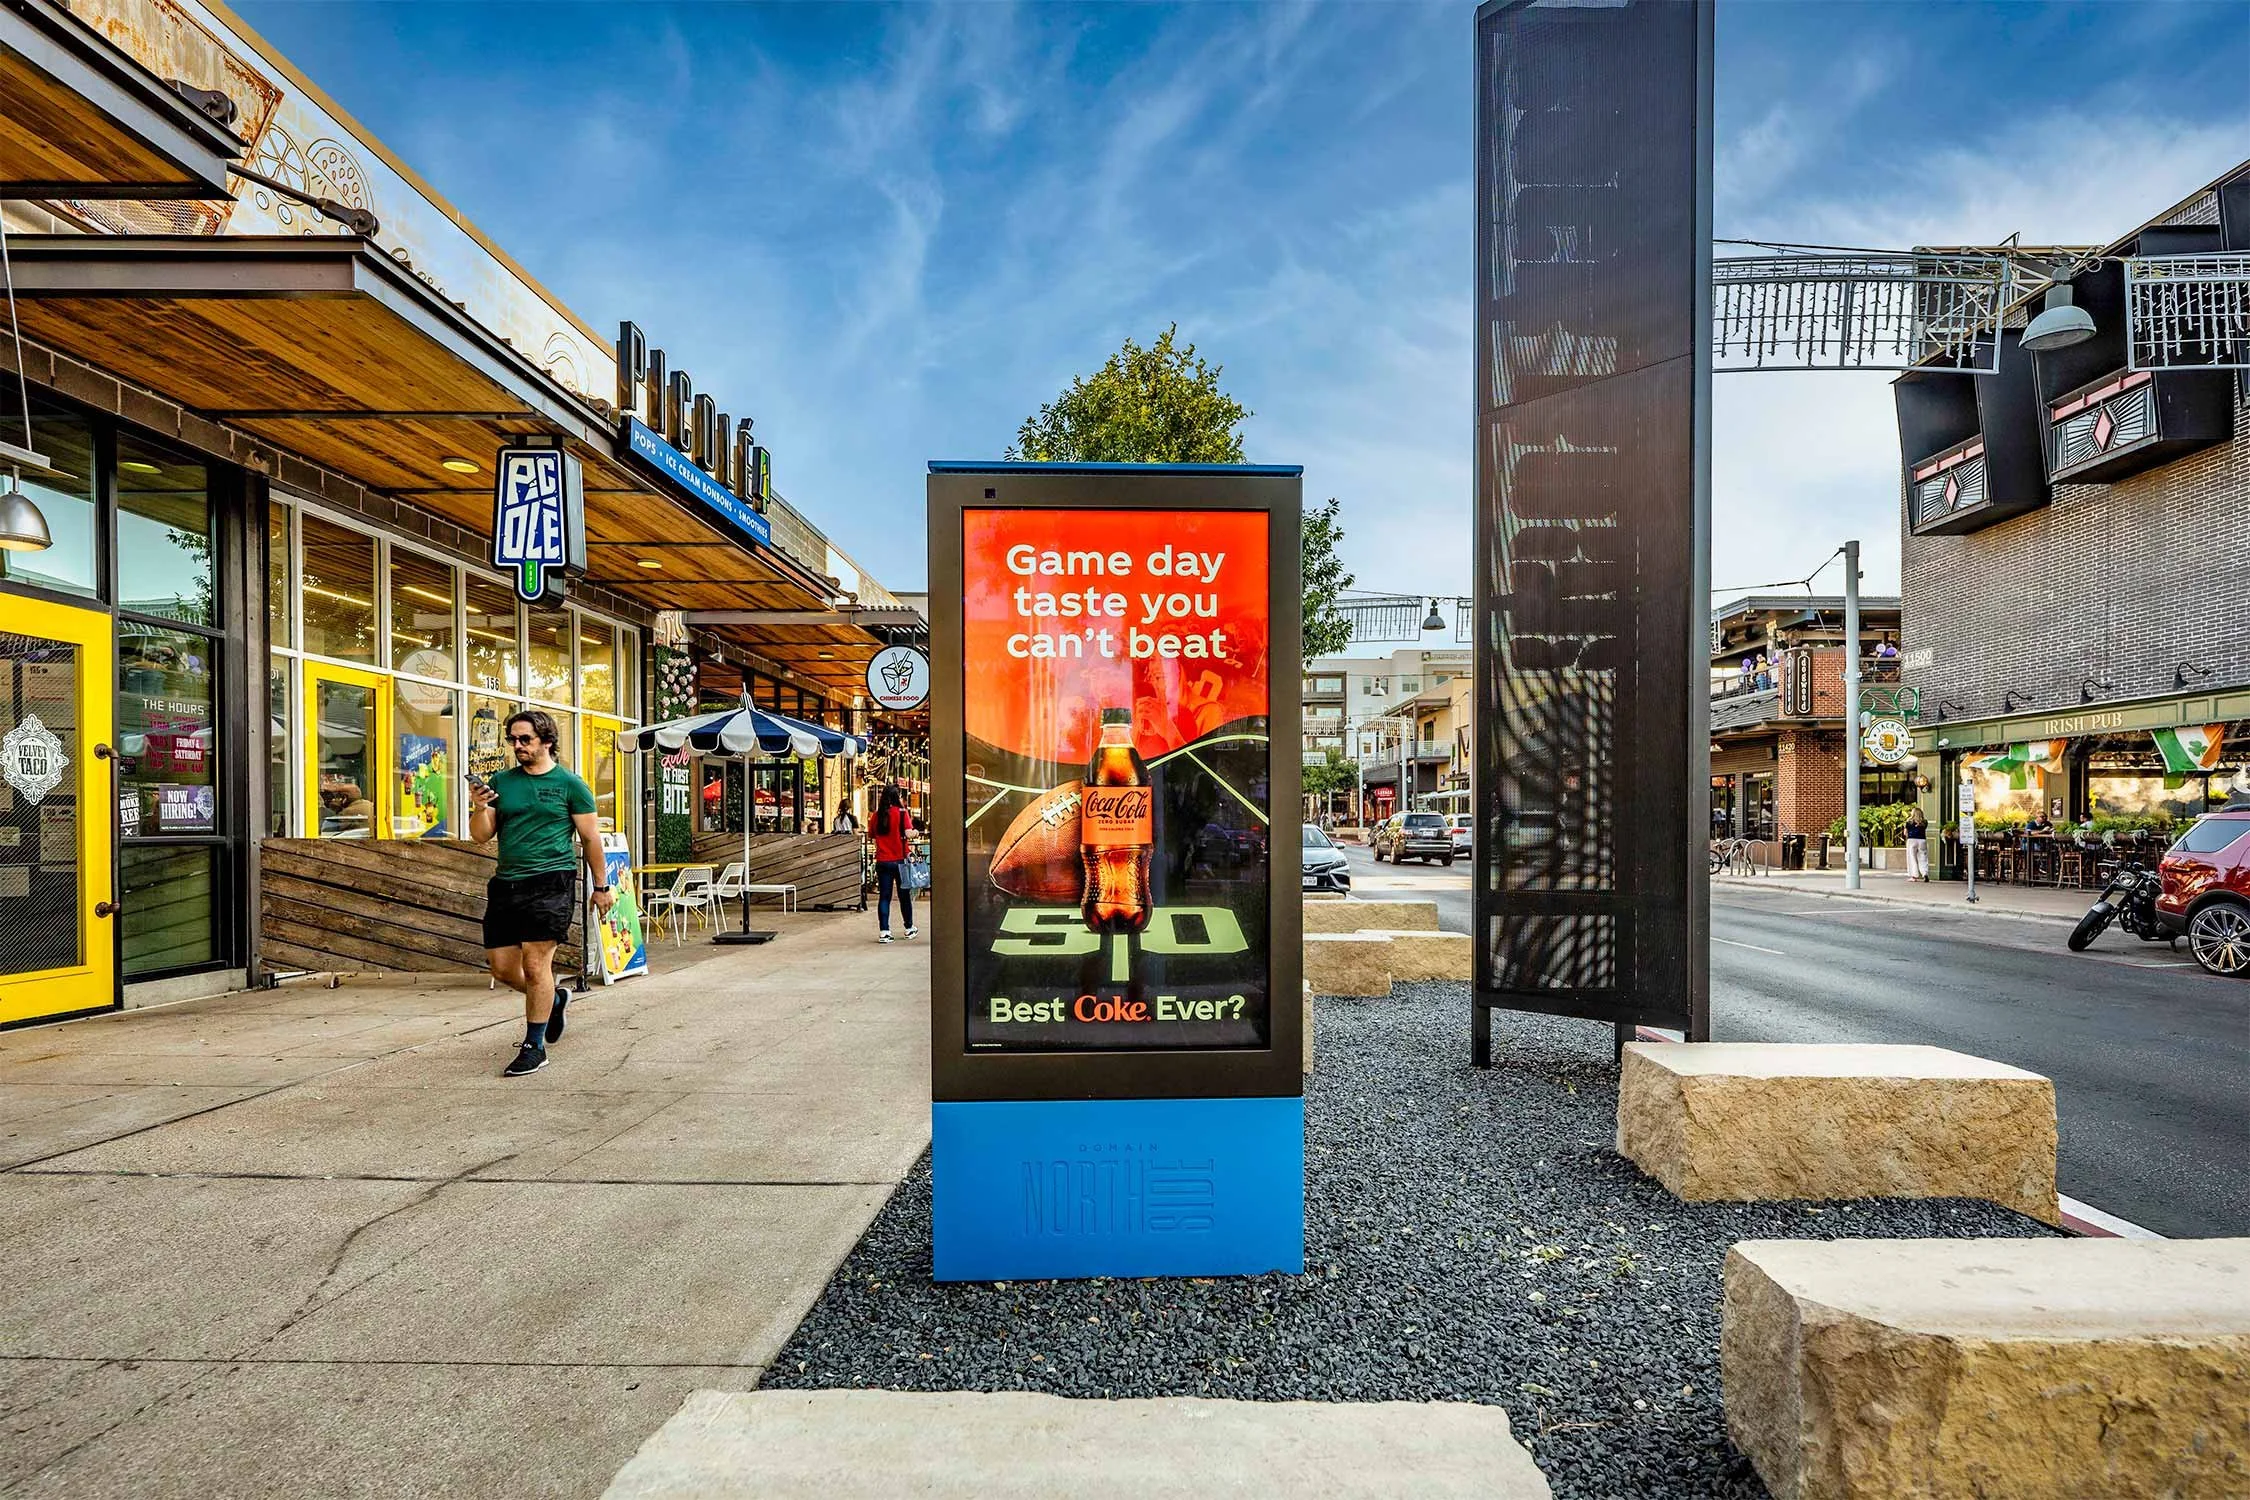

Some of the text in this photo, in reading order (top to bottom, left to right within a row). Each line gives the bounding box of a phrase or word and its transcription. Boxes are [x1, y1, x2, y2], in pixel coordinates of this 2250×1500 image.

[634, 429, 769, 539] POPS ICE CREAM BONBONS SMOOTHIES
[1006, 544, 1225, 583] Game day
[1014, 586, 1218, 624] taste you
[1007, 627, 1227, 659] can’t beat
[1903, 649, 1932, 665] 11500
[486, 676, 499, 691] 156
[142, 698, 205, 715] THE HOURS
[1876, 722, 1895, 733] JACK
[2044, 711, 2123, 735] IRISH PUB
[176, 737, 196, 748] FRIDAY
[18, 744, 47, 759] VELVET
[174, 748, 202, 760] SATURDAY
[19, 757, 47, 776] TACO
[663, 767, 689, 784] AT FIRST
[120, 797, 140, 810] MOKE
[167, 790, 189, 803] NOW
[663, 784, 690, 815] BITE
[1085, 790, 1148, 819] Coca-Cola
[121, 808, 140, 823] REE
[160, 802, 197, 819] HIRING!
[990, 998, 1065, 1023] Best
[1156, 995, 1246, 1021] Ever?
[1079, 1143, 1158, 1152] DOMAIN
[1021, 1158, 1214, 1235] NORTH SIDE
